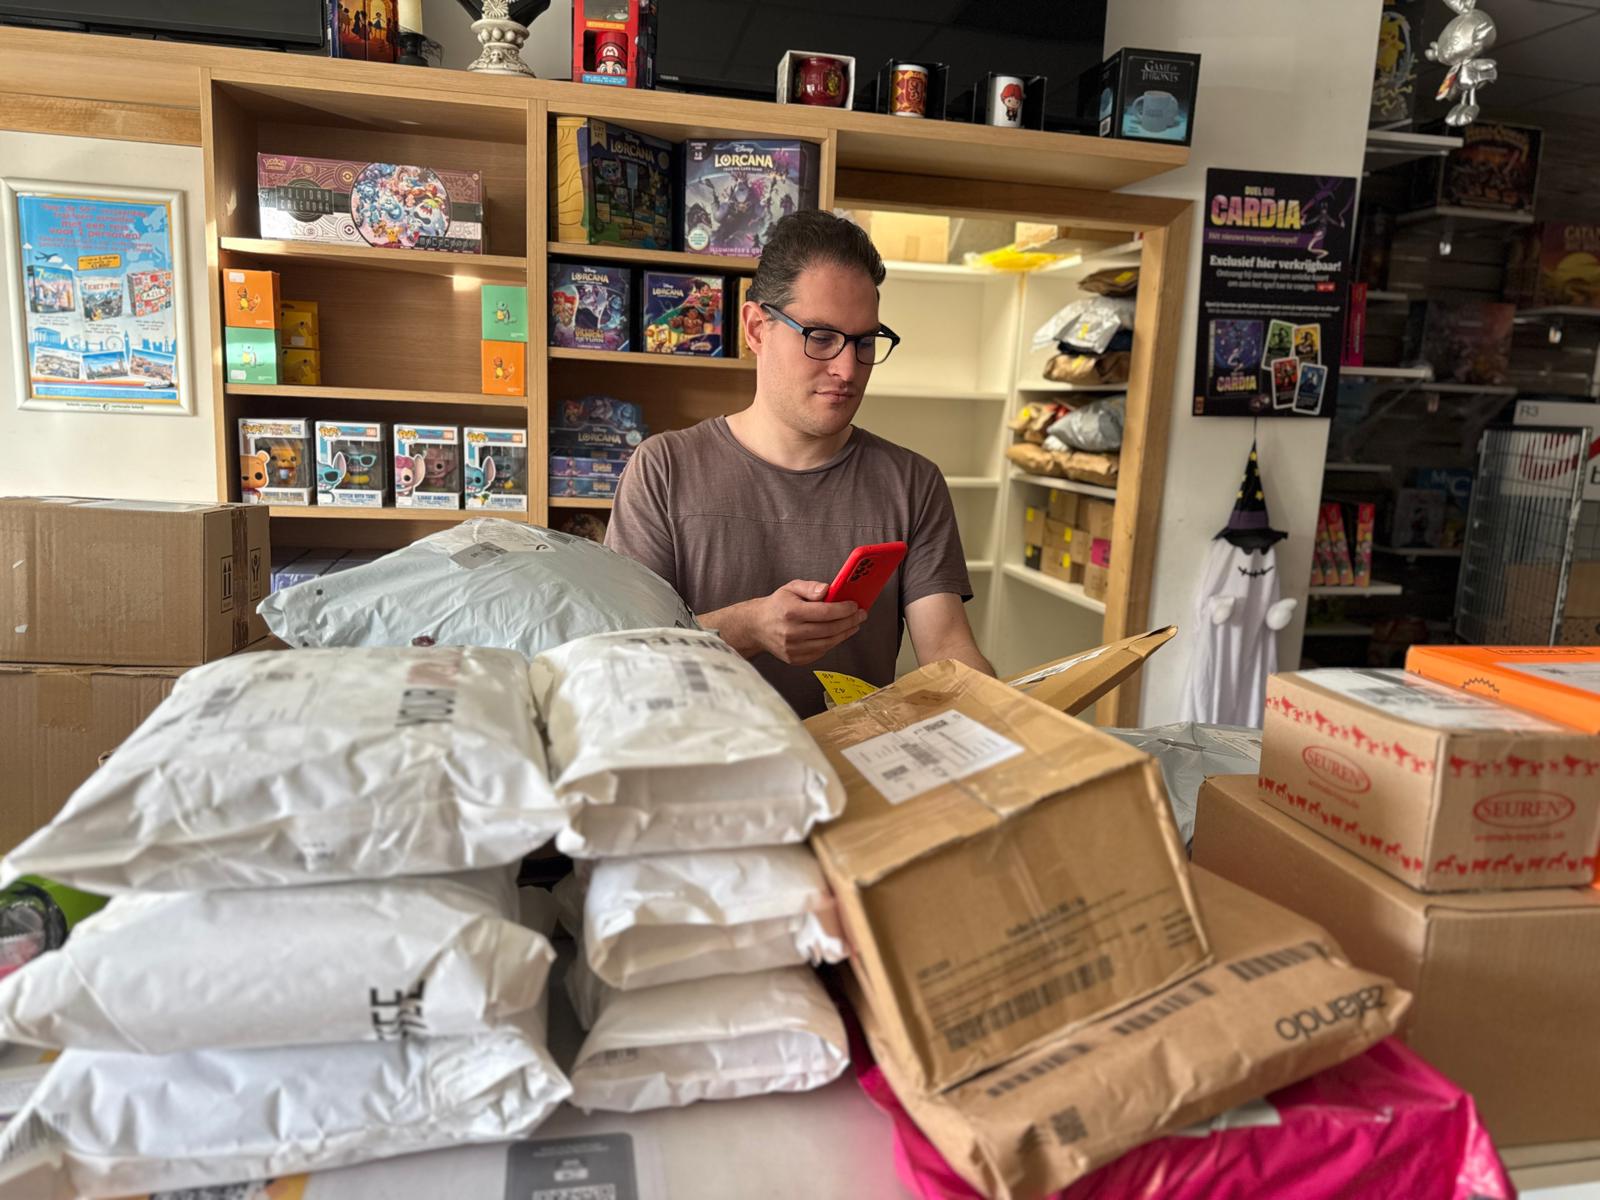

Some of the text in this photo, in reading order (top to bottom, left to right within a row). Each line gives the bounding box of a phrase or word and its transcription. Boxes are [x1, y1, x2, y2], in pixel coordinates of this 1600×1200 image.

[1144, 60, 1169, 72] GAME
[1141, 69, 1181, 83] THRONES
[610, 139, 655, 164] LORCANA
[734, 144, 755, 155] Disney
[714, 153, 774, 169] LORCANA
[279, 187, 331, 201] HOLIDAY
[279, 199, 331, 213] CALENDAR
[1210, 194, 1302, 230] CARDIA
[1209, 254, 1342, 274] Exclusief hier verkrijgbaar!
[571, 271, 610, 284] LORCANA
[652, 287, 685, 298] LORCANA
[1216, 375, 1257, 393] CARDIA
[578, 432, 622, 445] LORCANA
[1306, 747, 1361, 788] SEUREN
[1480, 798, 1562, 819] SEUREN
[1275, 984, 1387, 1041] zalando
